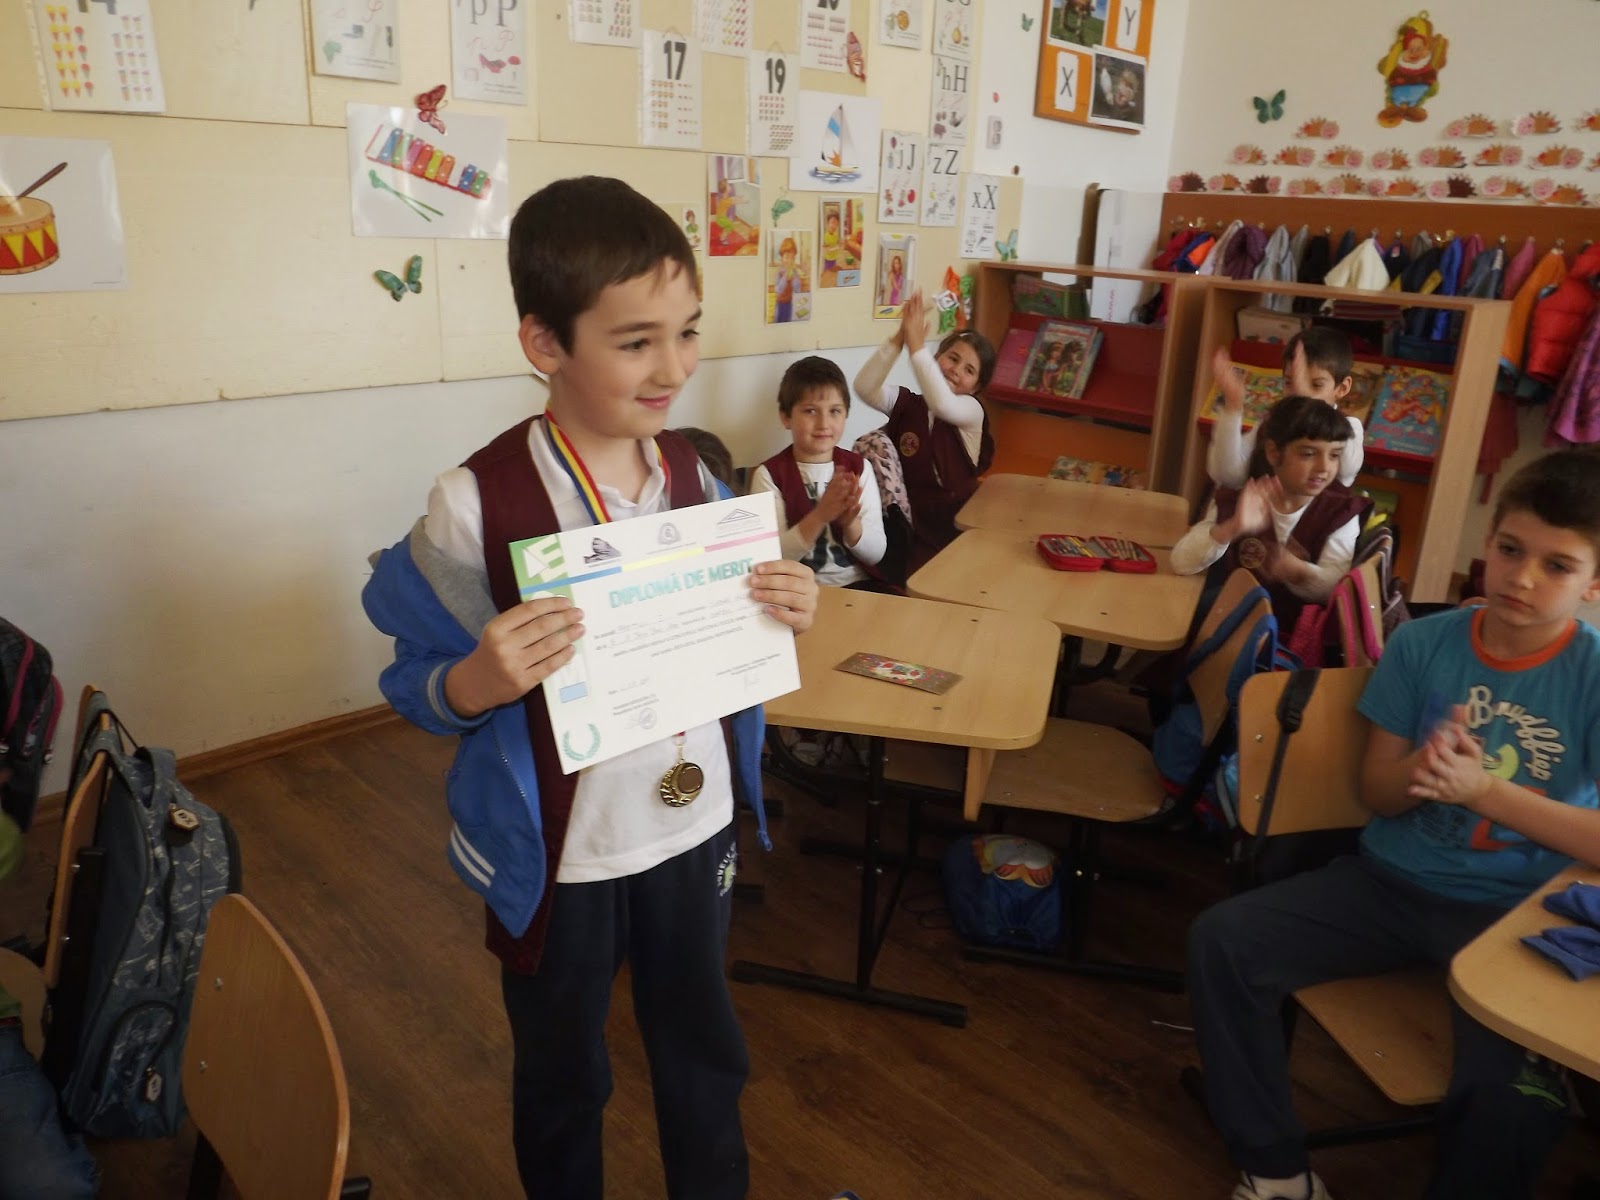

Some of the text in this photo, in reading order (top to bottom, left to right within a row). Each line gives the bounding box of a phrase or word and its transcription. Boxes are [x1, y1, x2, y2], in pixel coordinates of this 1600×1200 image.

[1124, 6, 1137, 36] Y
[663, 40, 687, 81] 17
[765, 58, 786, 94] 19
[1059, 66, 1074, 98] X
[684, 573, 706, 590] DE
[707, 557, 754, 582] MERIT
